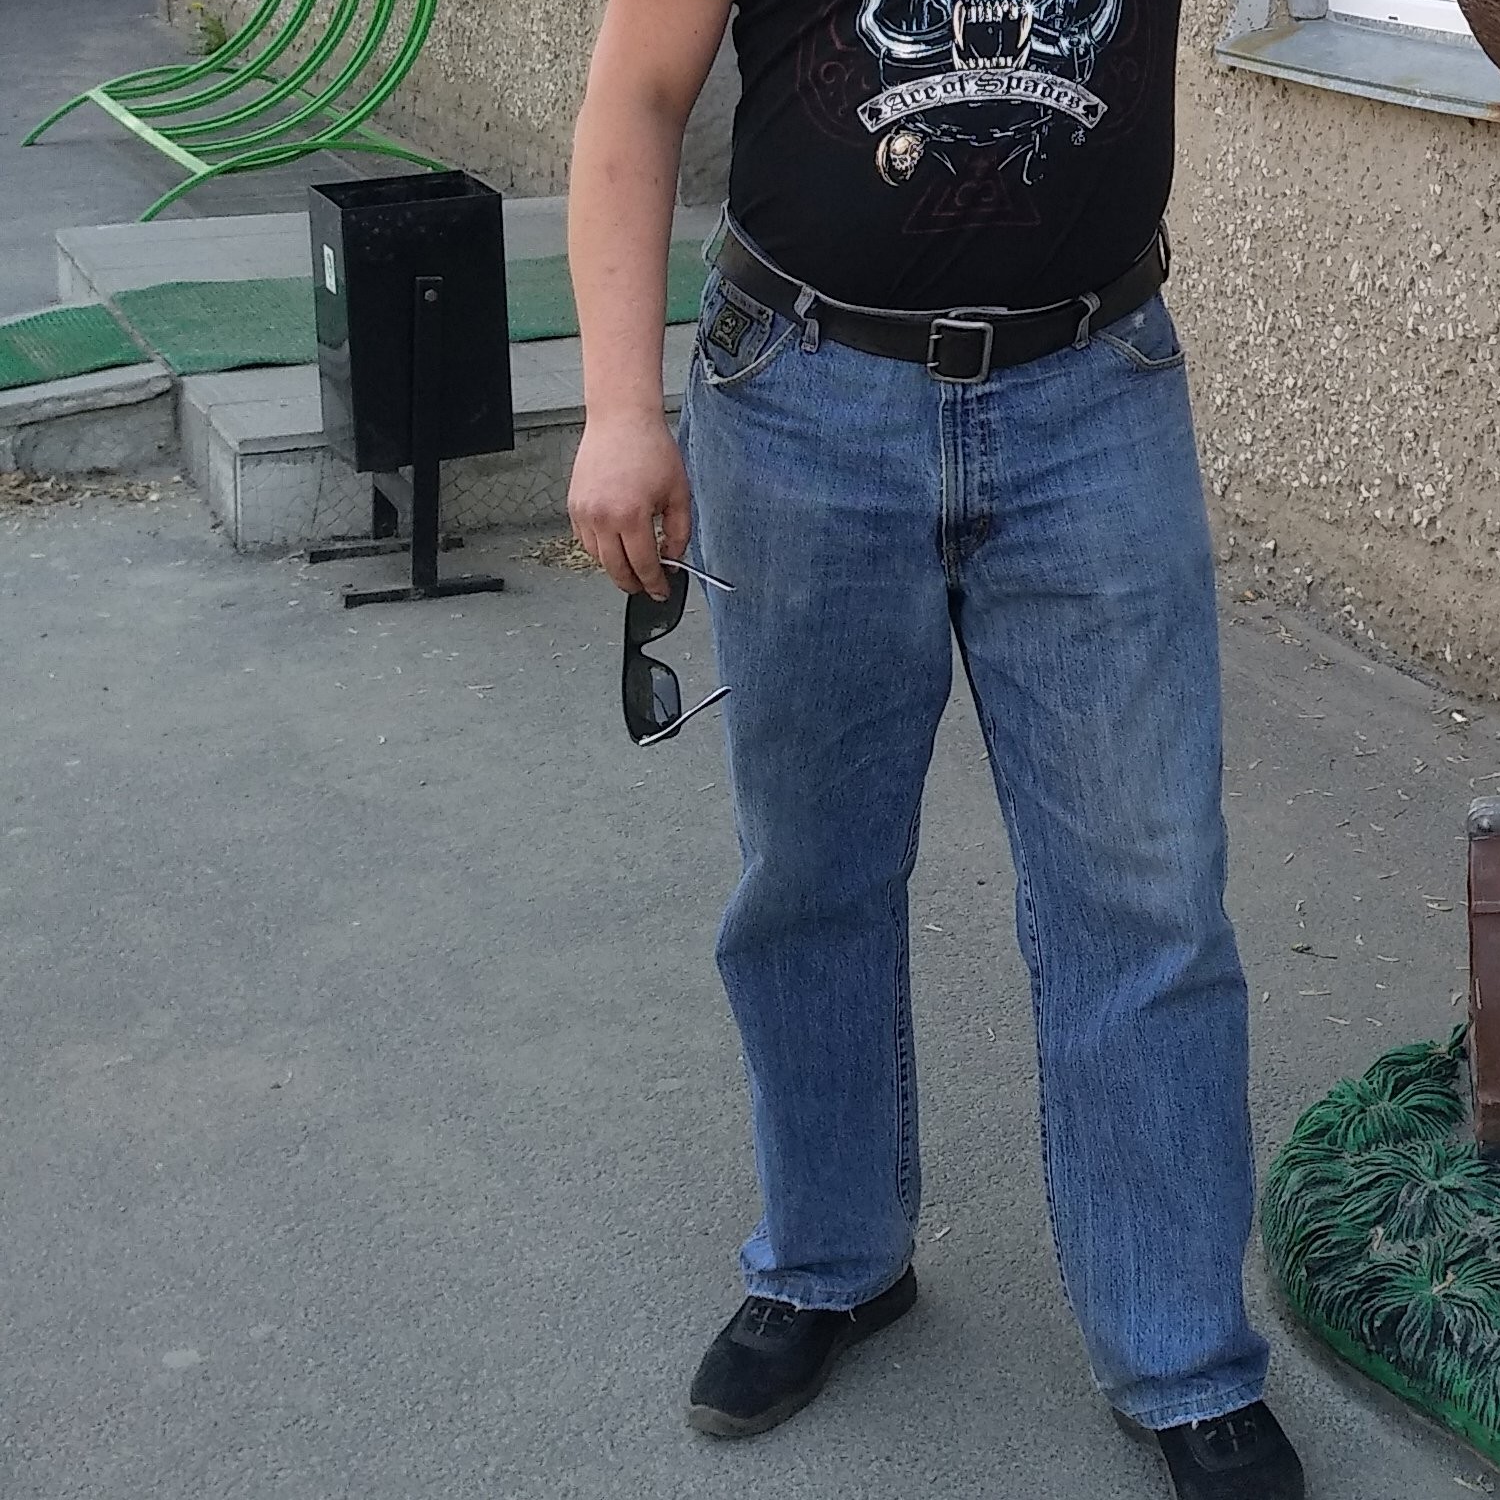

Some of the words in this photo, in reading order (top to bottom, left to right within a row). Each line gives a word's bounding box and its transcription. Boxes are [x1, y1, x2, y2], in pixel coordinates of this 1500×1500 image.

[884, 83, 937, 113] Ace
[942, 73, 971, 96] of
[974, 71, 1083, 109] Spades
